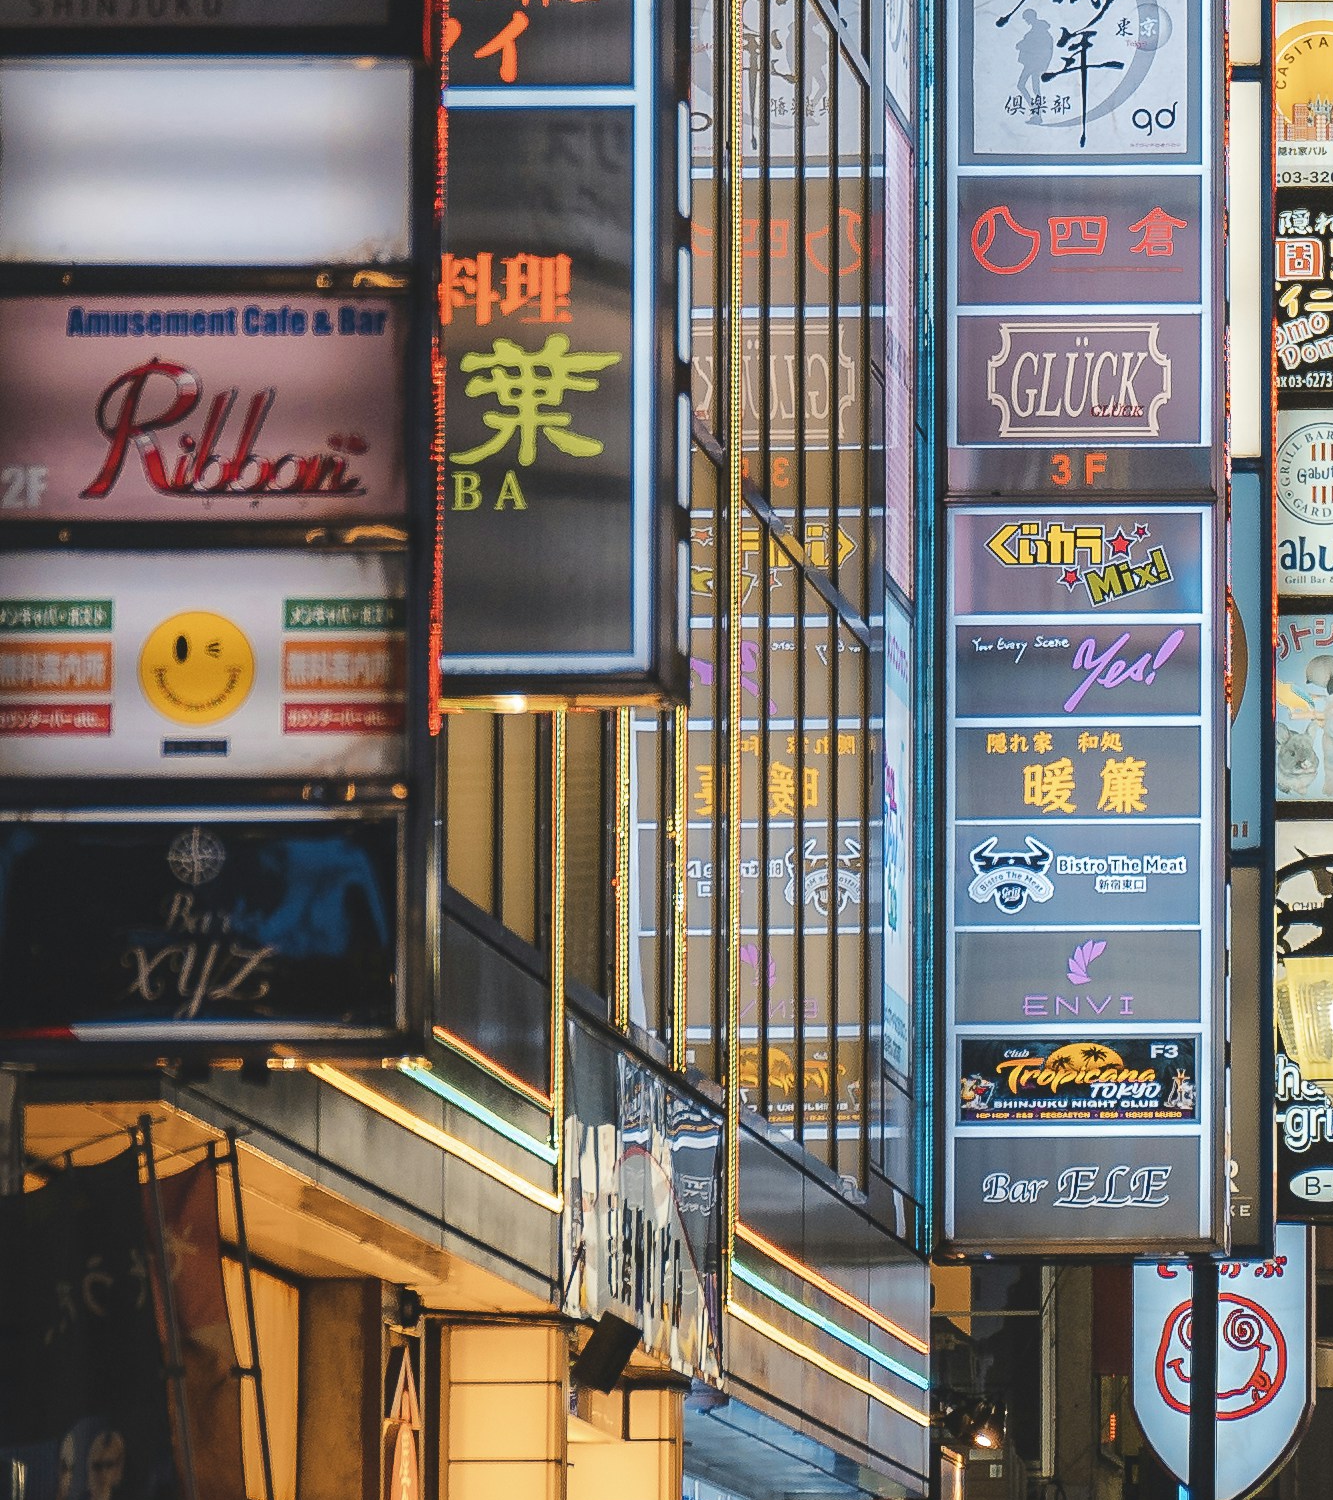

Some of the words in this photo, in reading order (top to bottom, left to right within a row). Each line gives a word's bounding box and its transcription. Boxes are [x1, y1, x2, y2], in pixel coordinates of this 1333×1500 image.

[440, 253, 572, 326] 料理
[66, 308, 238, 338] Amusement
[242, 306, 305, 338] Cafe
[338, 306, 387, 336] Bar
[1010, 337, 1148, 419] GLÜCK
[1284, 575, 1307, 585] Grill
[1310, 575, 1327, 585] Bar
[986, 731, 1053, 754] 隠れ家
[1023, 757, 1148, 814] 暖簾
[1059, 857, 1106, 874] Bistro
[1110, 857, 1140, 873] The
[1145, 857, 1185, 873] Meat
[1023, 995, 1134, 1016] ENVI
[1150, 1044, 1179, 1059] F3
[996, 1057, 1156, 1095] Tropicana
[1090, 1083, 1161, 1099] TOKYO
[1071, 1100, 1118, 1110] NIGHT
[1120, 1100, 1160, 1110] CLUB
[983, 1172, 1048, 1203] Bar
